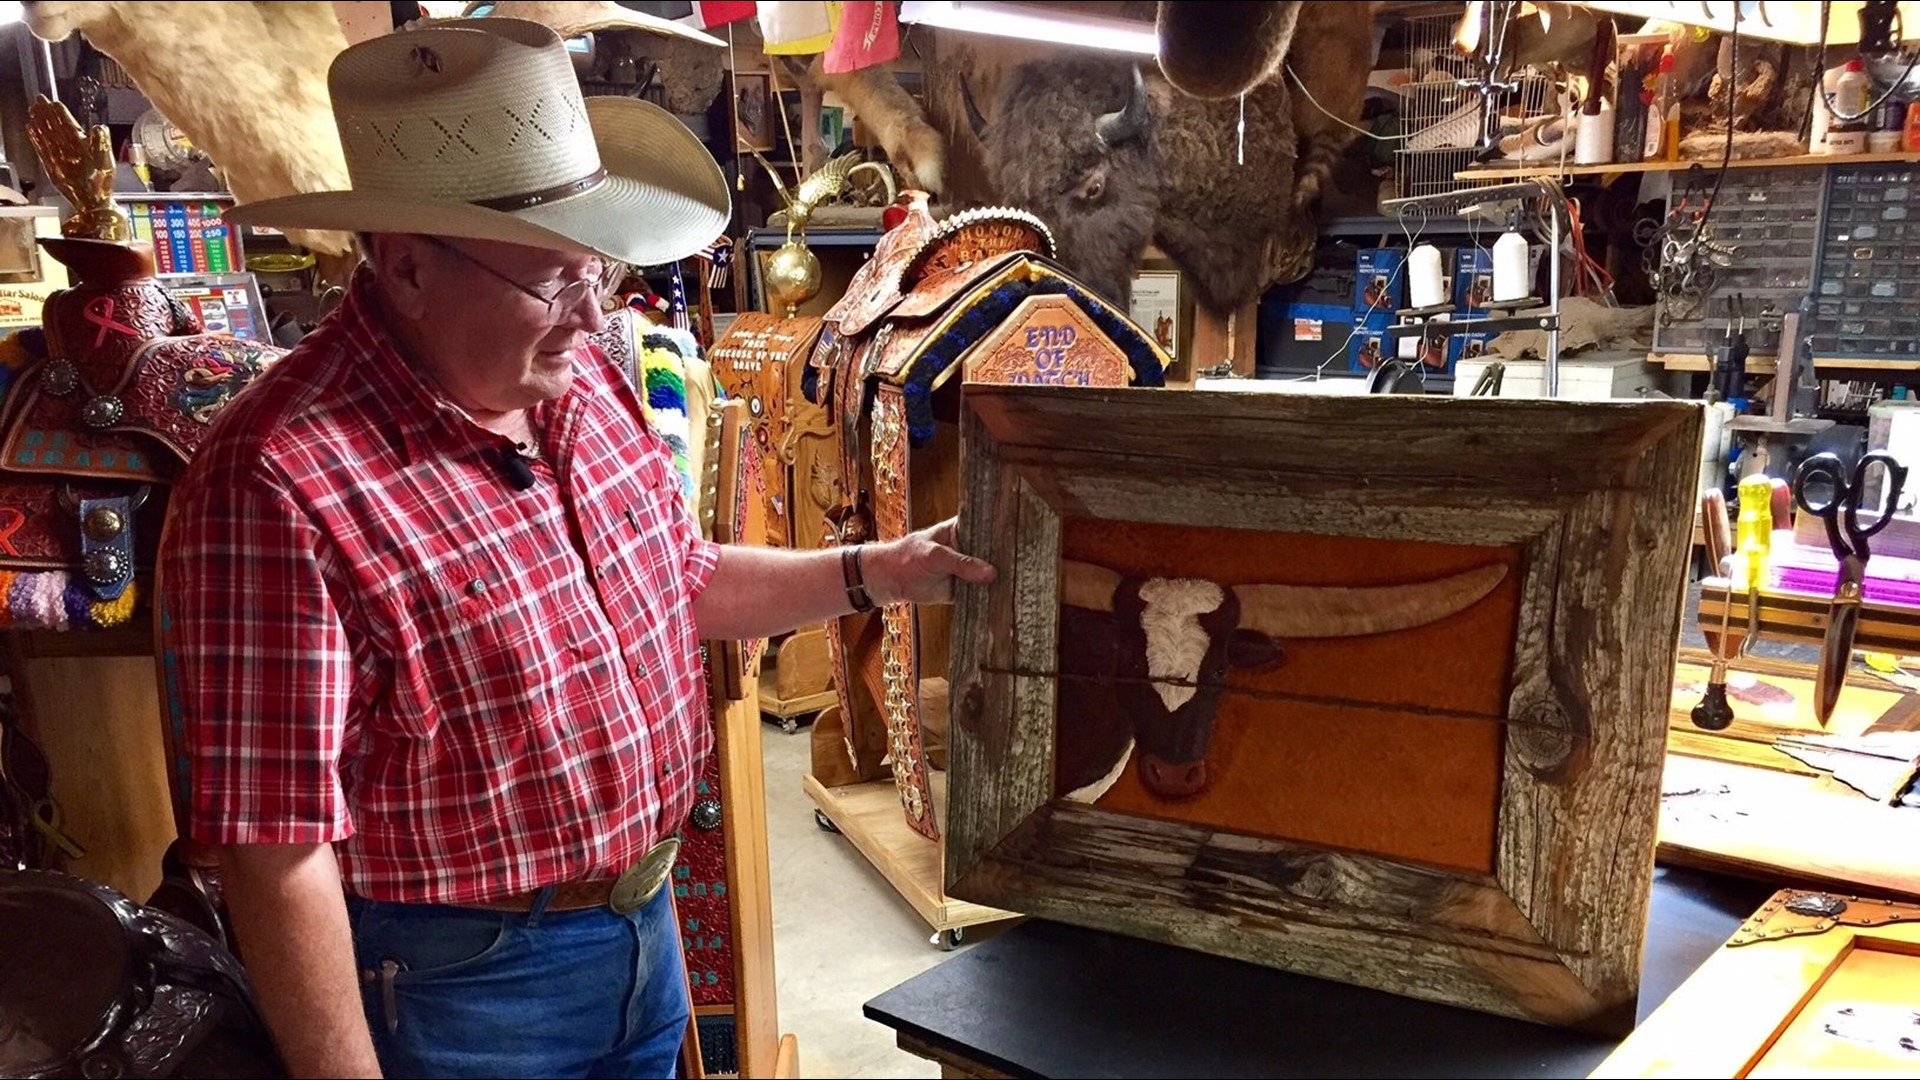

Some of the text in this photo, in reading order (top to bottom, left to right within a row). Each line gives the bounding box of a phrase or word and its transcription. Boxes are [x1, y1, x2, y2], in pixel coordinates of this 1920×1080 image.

[153, 218, 167, 228] 200
[170, 218, 185, 228] 300
[201, 218, 222, 228] 1000
[155, 230, 168, 239] 100
[173, 230, 186, 239] 150
[205, 229, 222, 238] 250
[959, 225, 1024, 241] HONOR
[1025, 325, 1077, 349] END
[715, 349, 752, 359] BECAUSE
[770, 352, 789, 361] THE
[1034, 349, 1067, 371] OF
[734, 361, 761, 370] BRAVE
[17, 449, 142, 470] BRAVE
